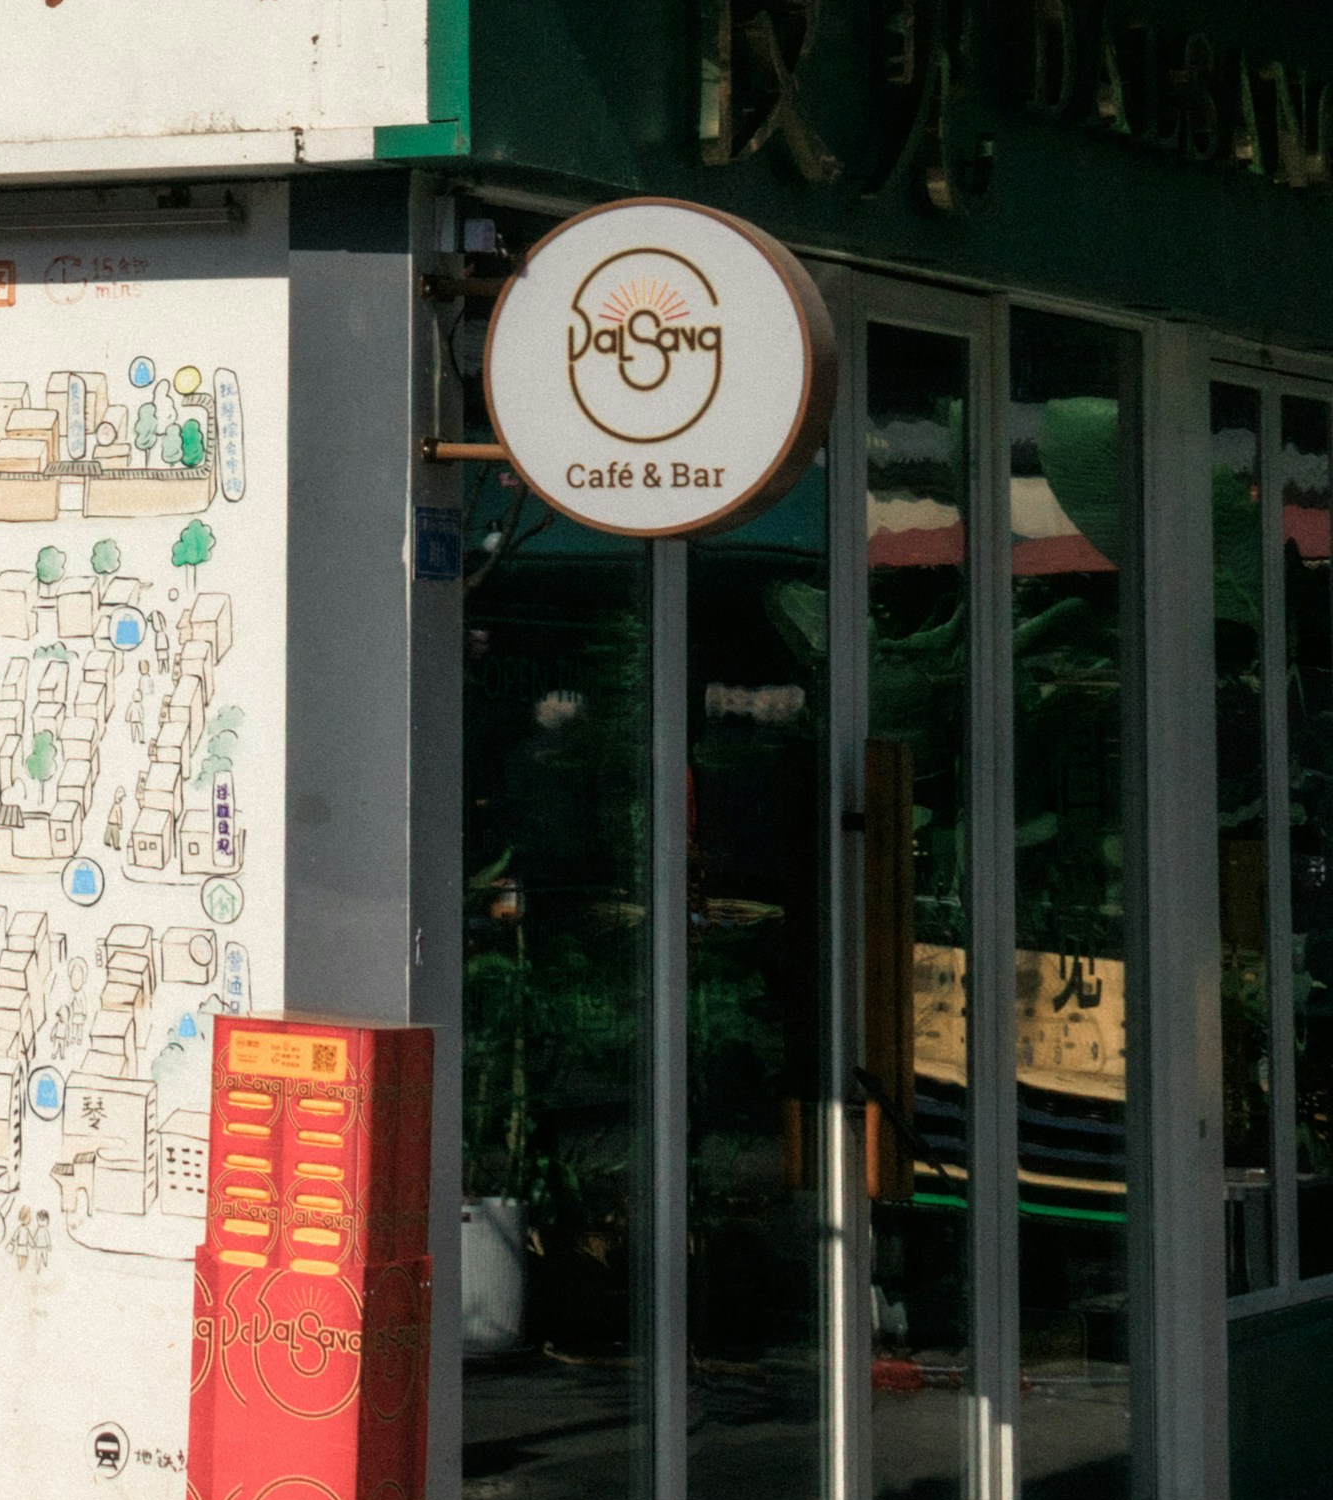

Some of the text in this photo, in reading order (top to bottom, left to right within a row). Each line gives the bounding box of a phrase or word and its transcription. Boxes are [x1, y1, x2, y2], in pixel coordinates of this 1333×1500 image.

[566, 460, 725, 489] Café & Bar
